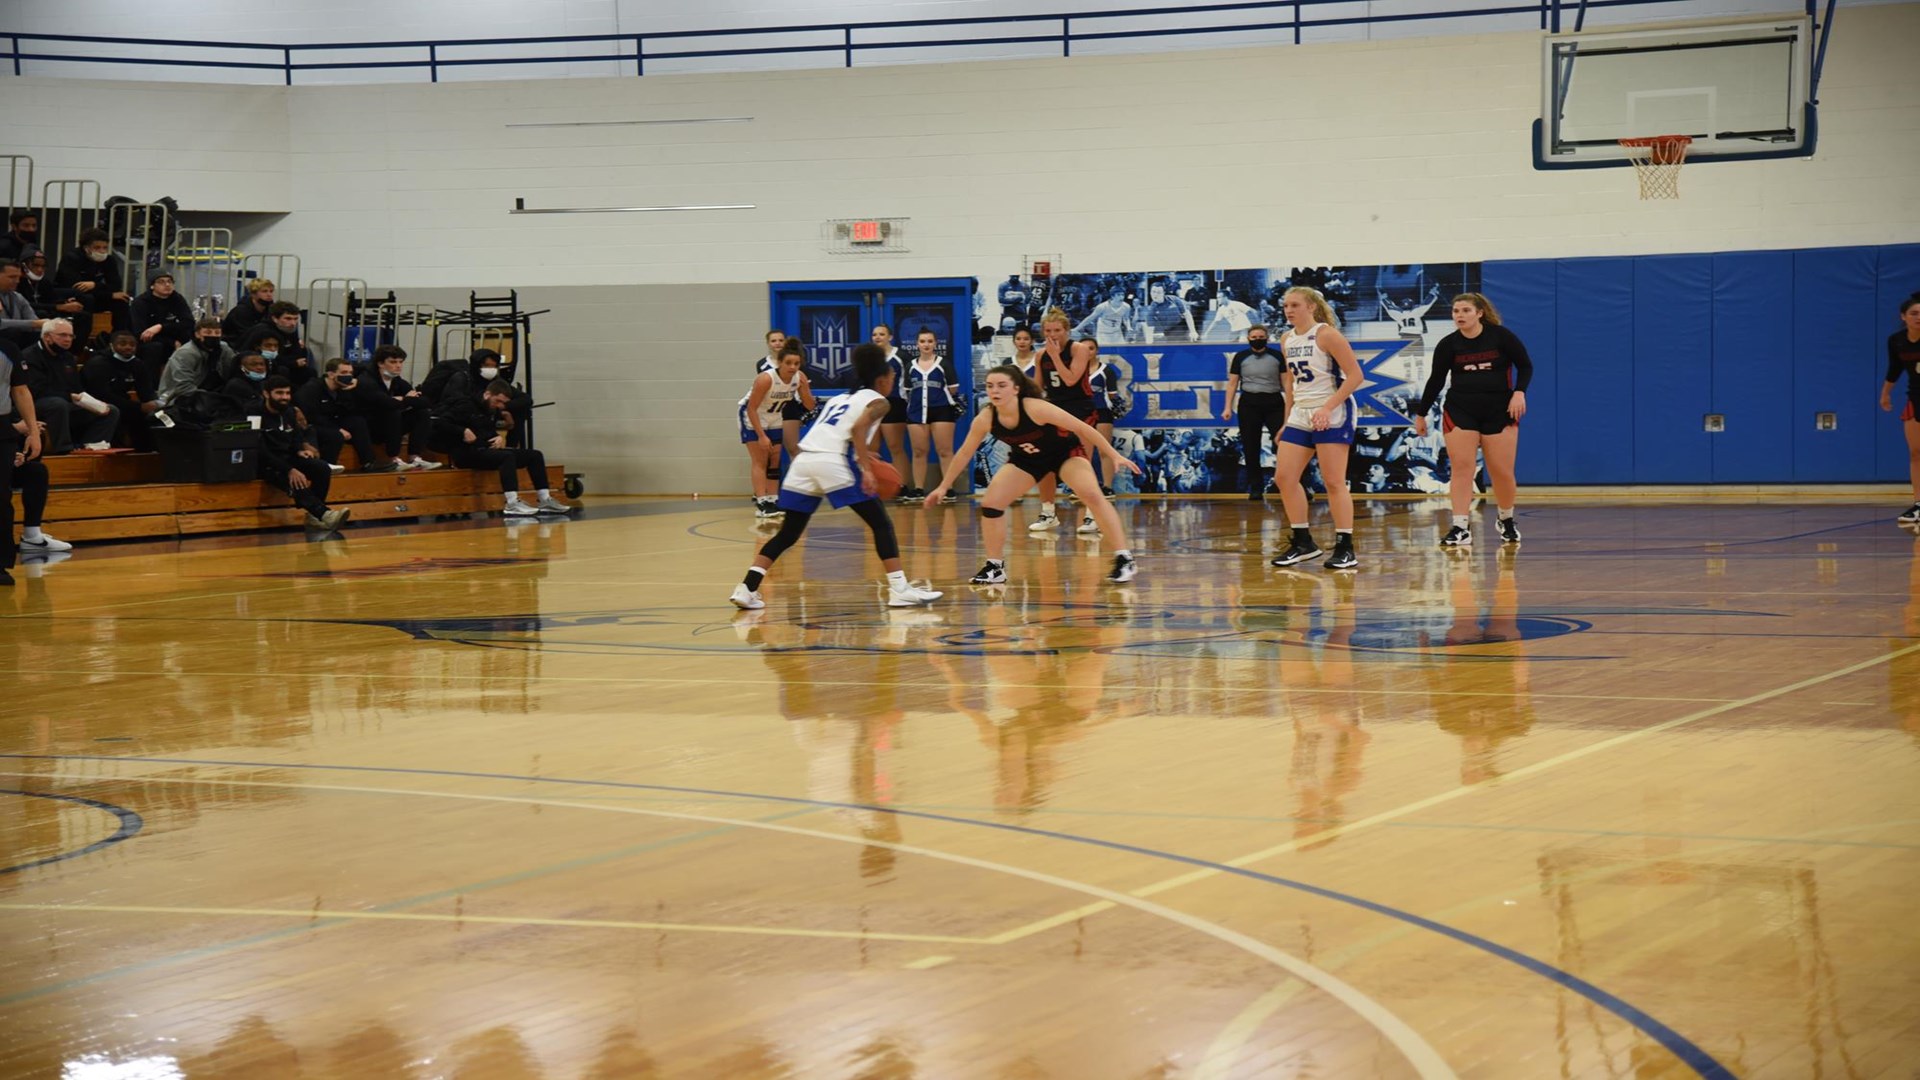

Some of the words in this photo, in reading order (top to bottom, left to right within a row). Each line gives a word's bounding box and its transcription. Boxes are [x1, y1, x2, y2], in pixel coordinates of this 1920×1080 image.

[853, 222, 878, 240] EXIT
[1402, 317, 1416, 327] 16
[1049, 370, 1061, 388] 5
[819, 403, 850, 426] 12
[1018, 442, 1041, 454] 2
